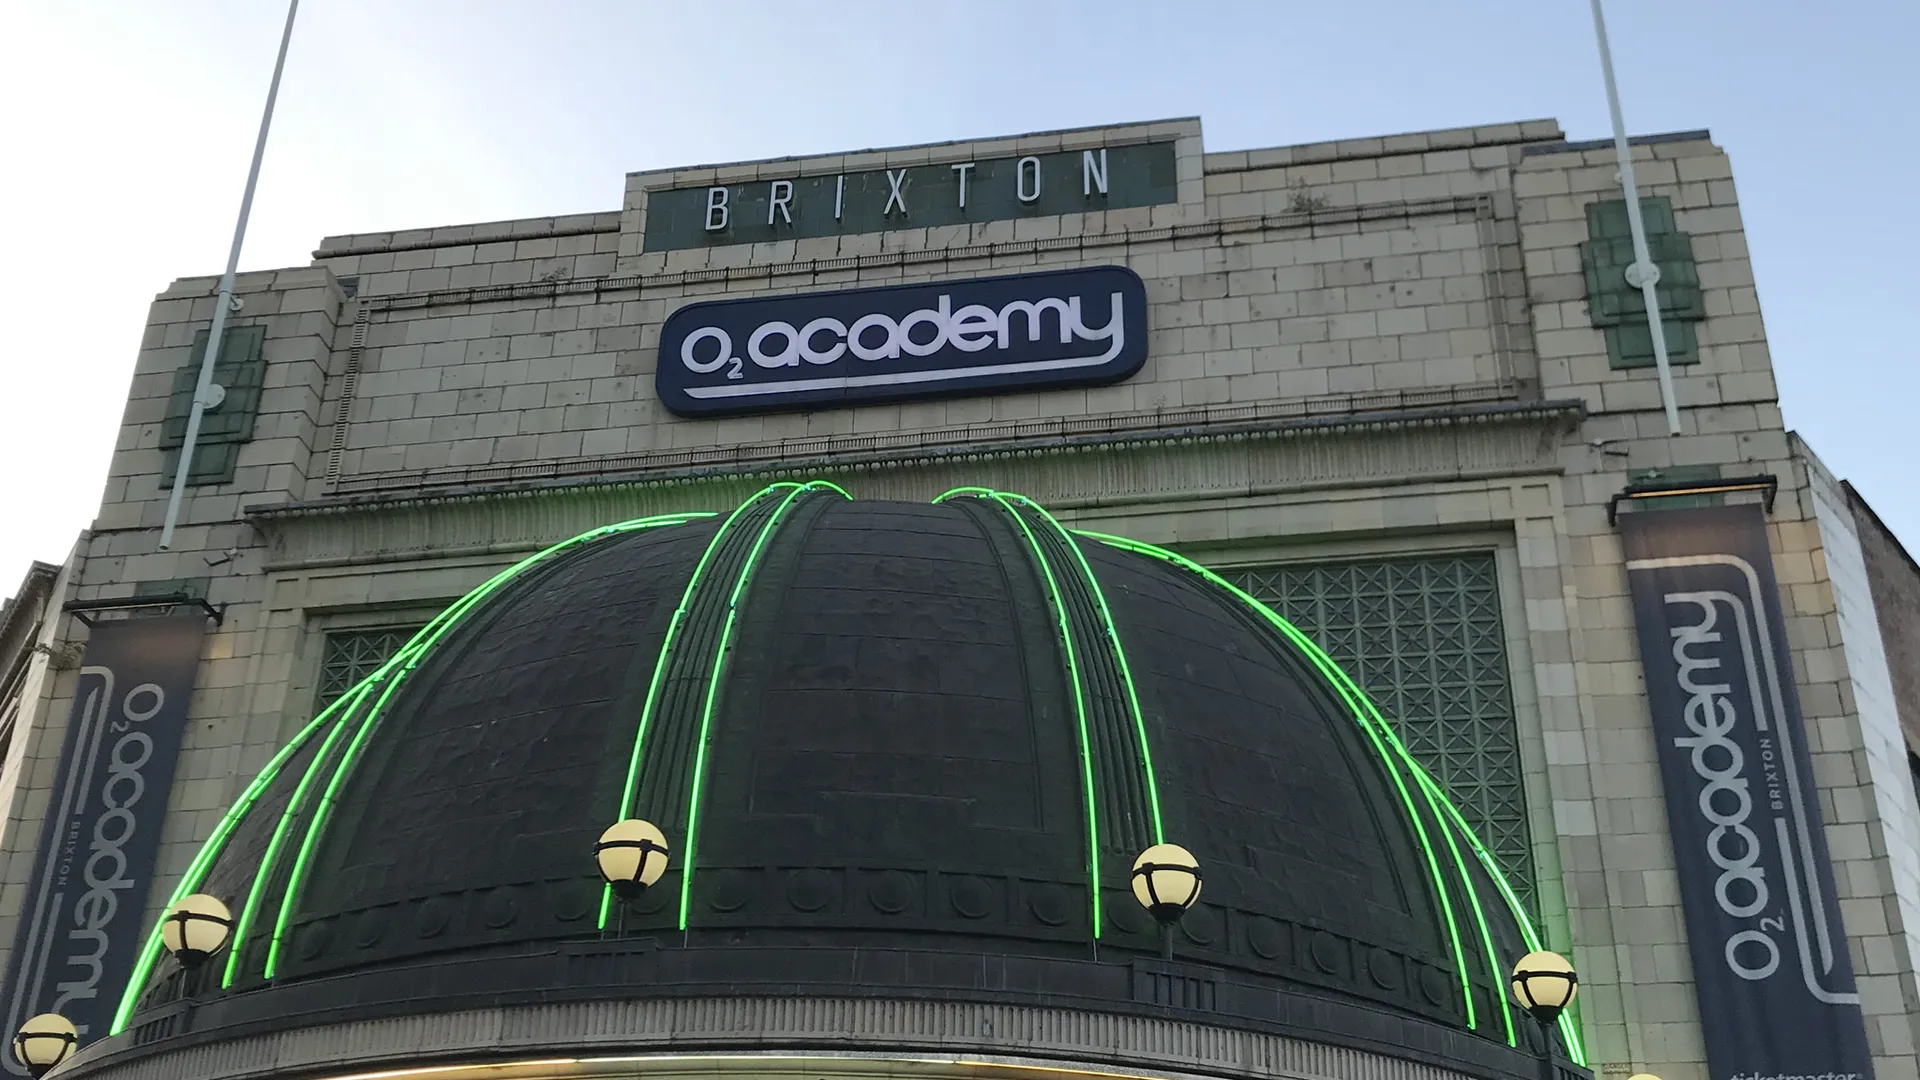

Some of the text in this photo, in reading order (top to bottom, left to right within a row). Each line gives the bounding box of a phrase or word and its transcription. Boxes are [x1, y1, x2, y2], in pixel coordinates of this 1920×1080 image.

[705, 149, 1107, 231] BRIXTON
[747, 292, 1123, 368] academy
[1663, 591, 1769, 919] academy
[1760, 739, 1784, 810] BRIXTON
[57, 821, 81, 886] BRIXTON
